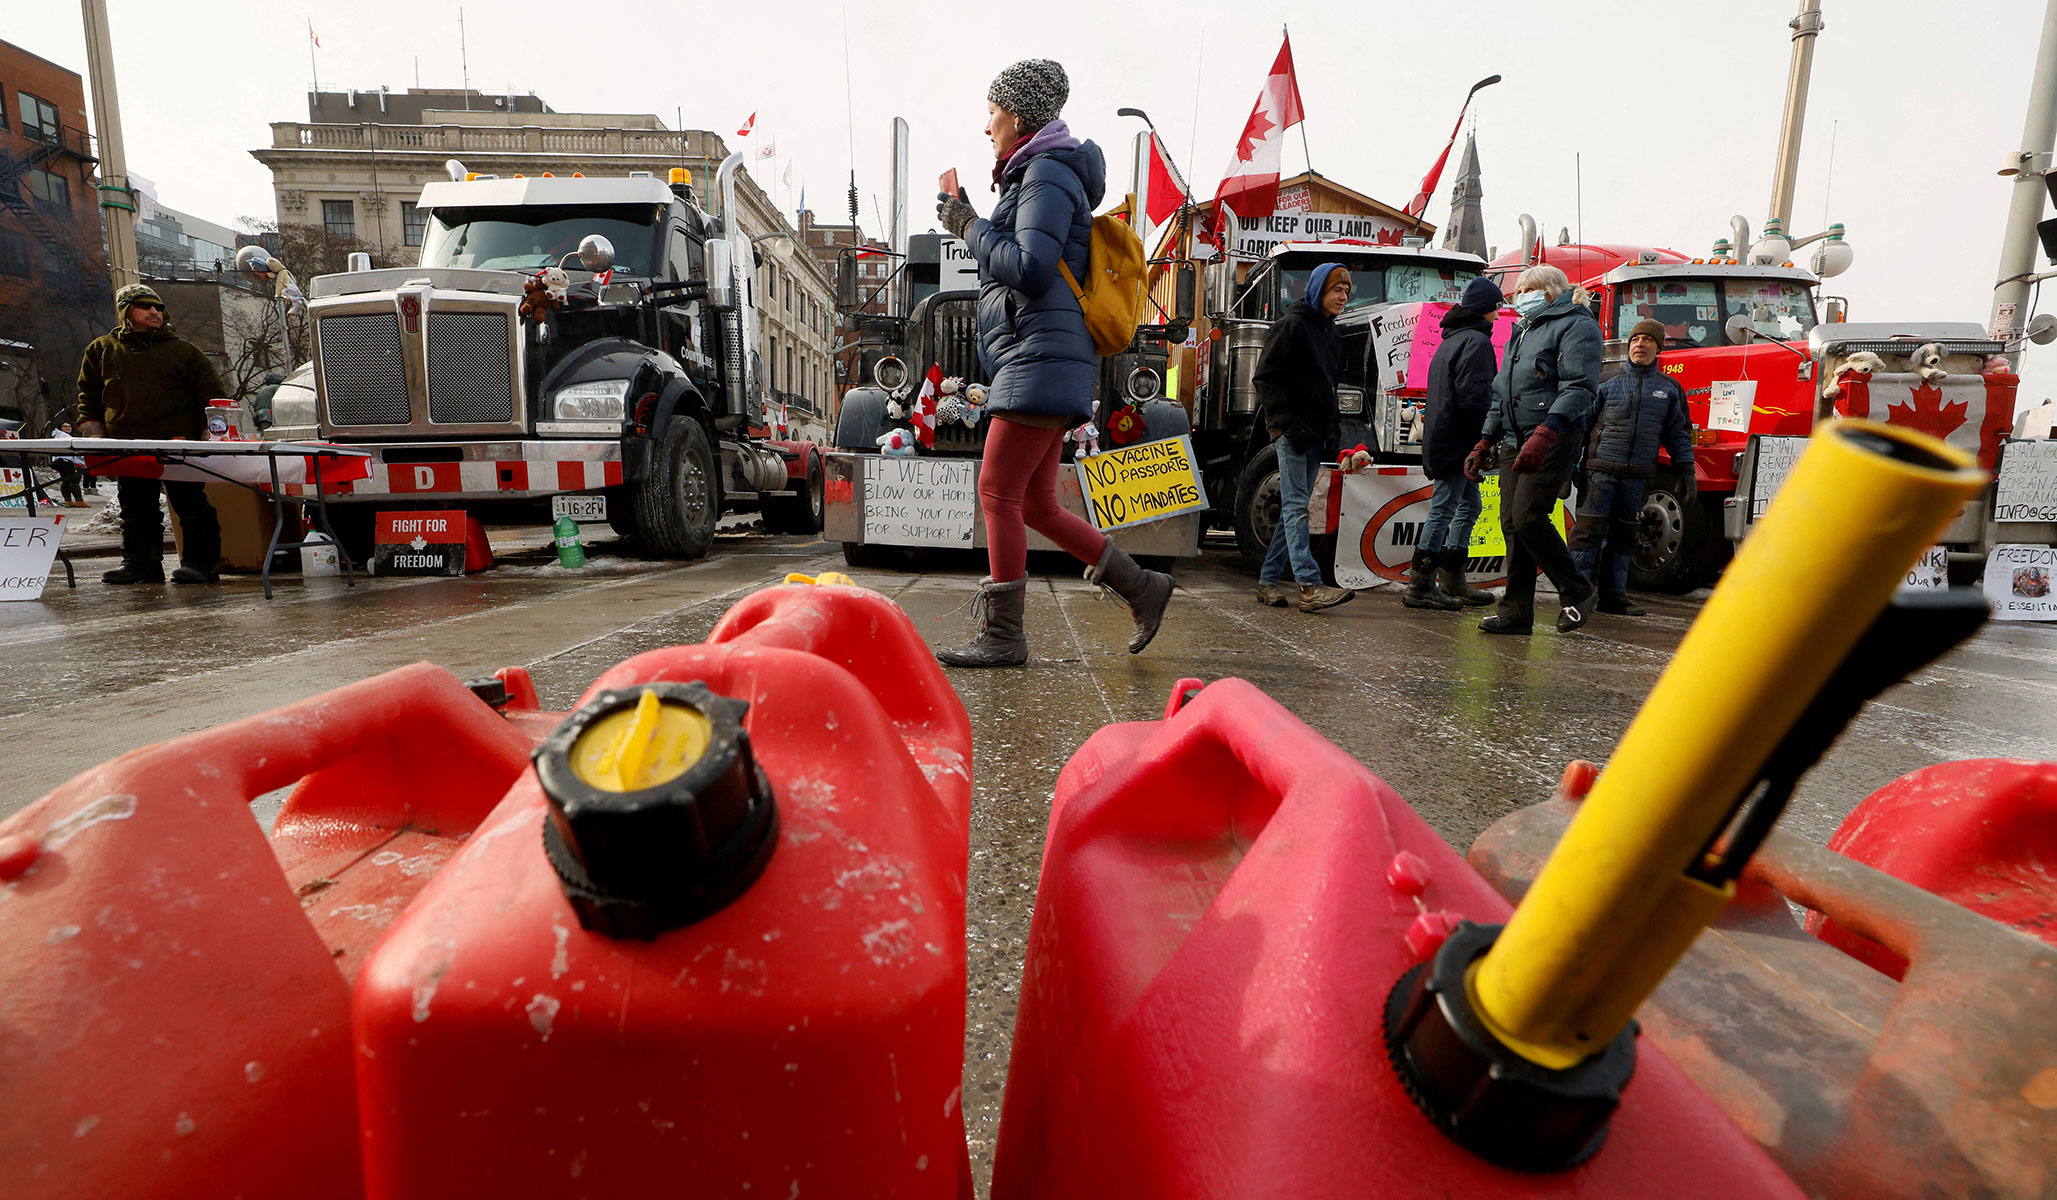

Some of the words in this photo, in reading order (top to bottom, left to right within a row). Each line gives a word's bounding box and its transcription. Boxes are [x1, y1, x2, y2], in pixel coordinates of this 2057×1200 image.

[1278, 195, 1293, 205] FOR
[1293, 190, 1309, 200] OUR
[1278, 198, 1311, 211] LEADERS
[1238, 215, 1259, 231] OD
[1266, 215, 1299, 234] KEEP
[1305, 217, 1332, 236] OUR
[1338, 219, 1376, 240] LAND,
[1391, 330, 1412, 344] over
[1387, 348, 1412, 368] Fea
[1662, 363, 1684, 374] 1948
[864, 458, 885, 481] IF
[898, 459, 923, 484] WE
[1084, 460, 1117, 492] NO
[1109, 441, 1180, 465] VACCINE
[1119, 456, 1190, 483] PASSPORTS
[2002, 460, 2048, 475] GENERAL
[414, 466, 435, 490] D
[864, 483, 905, 500] BLOW
[913, 488, 935, 500] OUR
[865, 505, 908, 518] BRING
[1092, 493, 1126, 529] NO
[1129, 483, 1200, 514] MANDATES
[392, 519, 422, 533] FIGHT
[426, 519, 447, 532] FOR
[866, 523, 893, 536] FOR
[393, 555, 443, 568] FREEDOM
